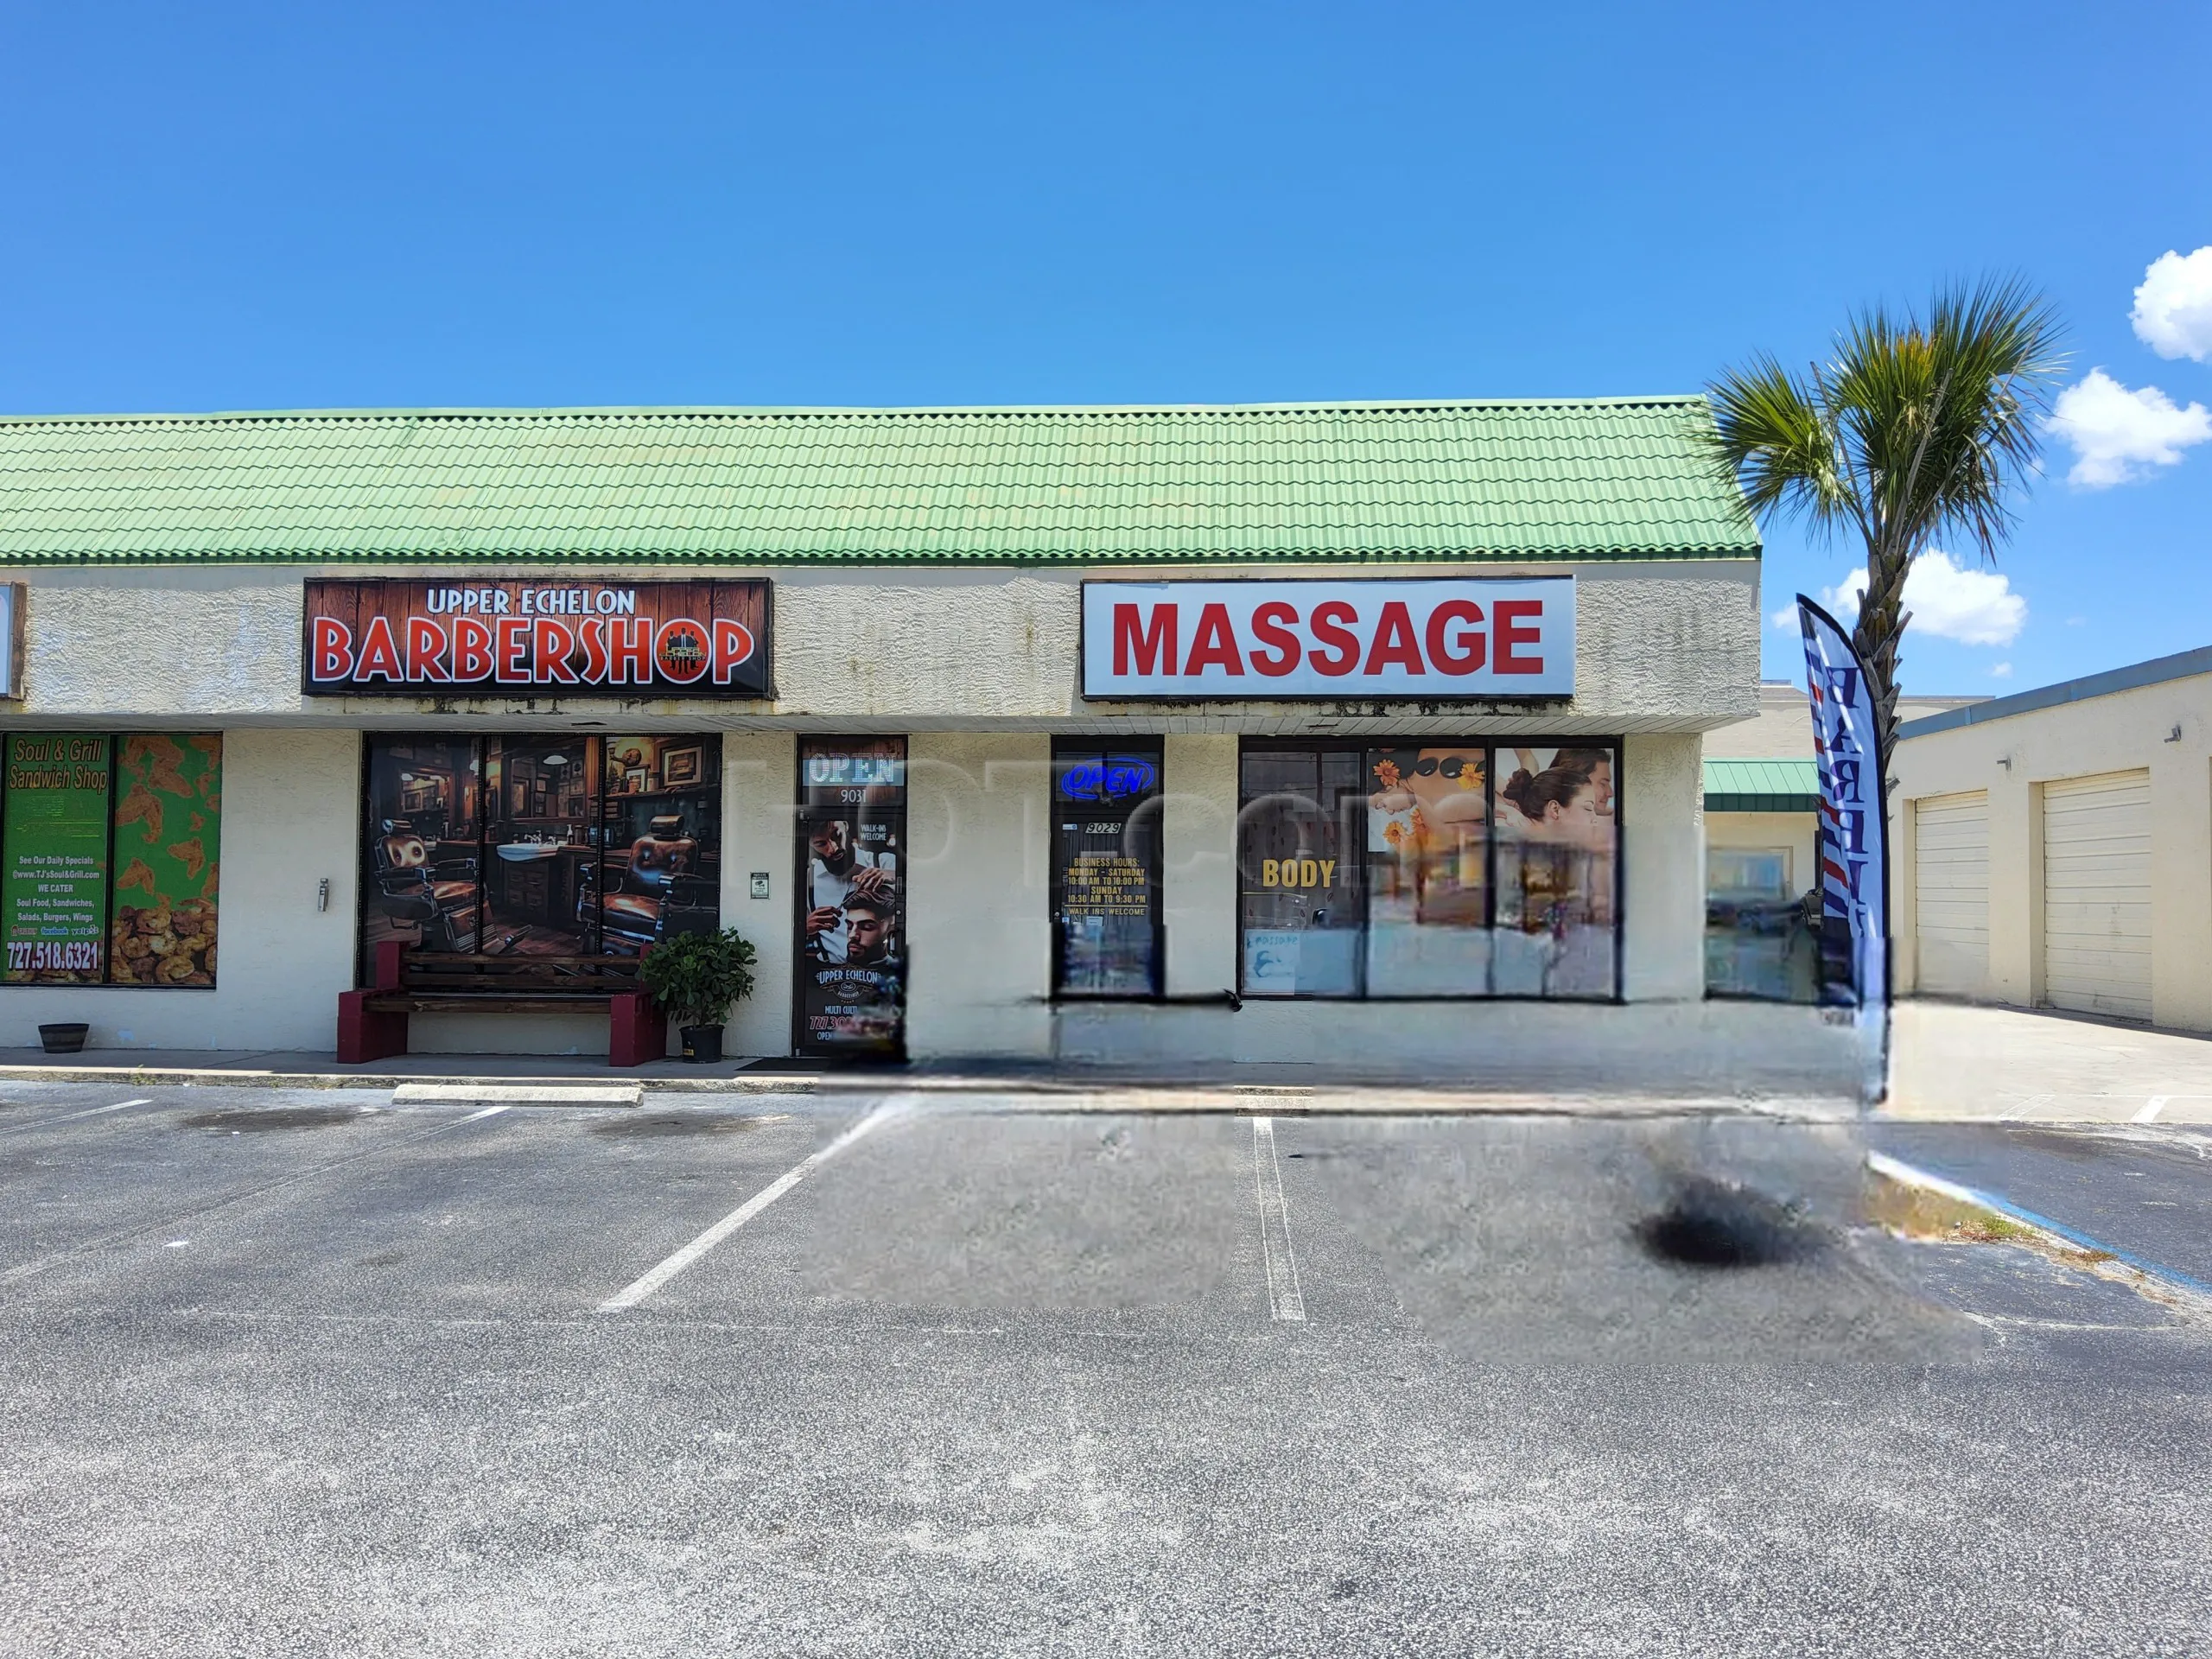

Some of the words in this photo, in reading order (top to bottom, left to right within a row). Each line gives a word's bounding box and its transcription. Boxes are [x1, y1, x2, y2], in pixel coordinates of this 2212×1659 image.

[427, 588, 509, 615] UPPER
[521, 588, 635, 615] ECHELON
[1112, 600, 1544, 677] MASSAGE
[312, 616, 755, 685] BARBERSHOP
[15, 739, 51, 761] Soul
[54, 739, 66, 761] &
[69, 739, 103, 761] Grill
[809, 753, 897, 783] OPEN
[9, 765, 71, 789] Sandwich
[73, 765, 108, 795] Shop
[1068, 764, 1145, 793] OPEN
[840, 789, 868, 803] 9031
[1087, 823, 1120, 833] 9029
[47, 856, 64, 866] Daily
[65, 856, 93, 866] Specials
[1074, 857, 1110, 867] BUSINESS
[1113, 857, 1141, 867] HOURS:
[1262, 859, 1337, 888] BODY
[38, 884, 49, 893] WE
[50, 884, 73, 893] CATER
[1068, 877, 1088, 886] 10:00
[1089, 877, 1100, 886] AM
[1103, 877, 1112, 886] TO
[1113, 877, 1133, 886] 10:00
[1134, 877, 1145, 886] PM
[16, 899, 31, 907] Soul
[32, 899, 51, 908] Food,
[53, 899, 95, 908] Sandwiches,
[1067, 894, 1087, 903] 10:30
[1135, 895, 1147, 904] PM
[17, 912, 41, 922] Salads,
[43, 912, 72, 923] Burgers,
[73, 912, 93, 923] Wings
[7, 941, 98, 969] 727.518.6321
[819, 970, 843, 984] UPPER
[845, 970, 878, 984] ECHELON
[824, 1006, 842, 1014] MULTI
